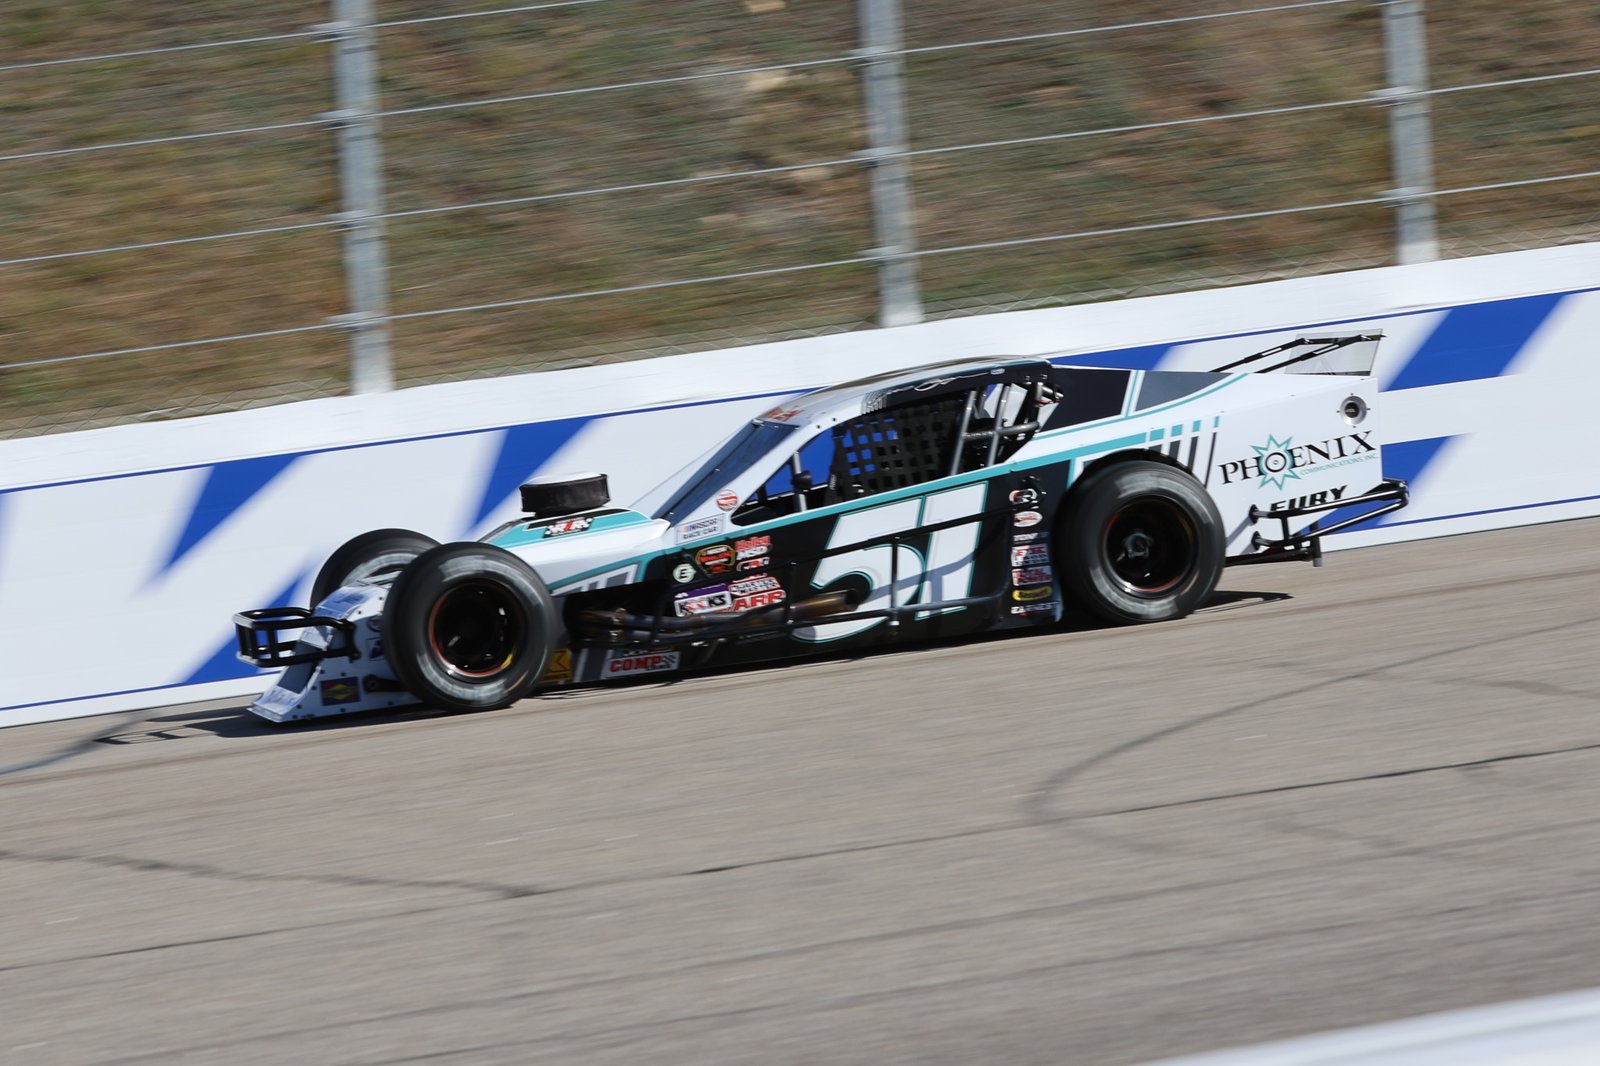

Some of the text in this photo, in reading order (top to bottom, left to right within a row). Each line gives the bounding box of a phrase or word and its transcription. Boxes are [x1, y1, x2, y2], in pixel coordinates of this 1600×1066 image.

[1218, 430, 1376, 485] PHOENIX
[1269, 484, 1348, 511] FURY
[791, 481, 990, 643] 51
[609, 656, 663, 673] COMP
